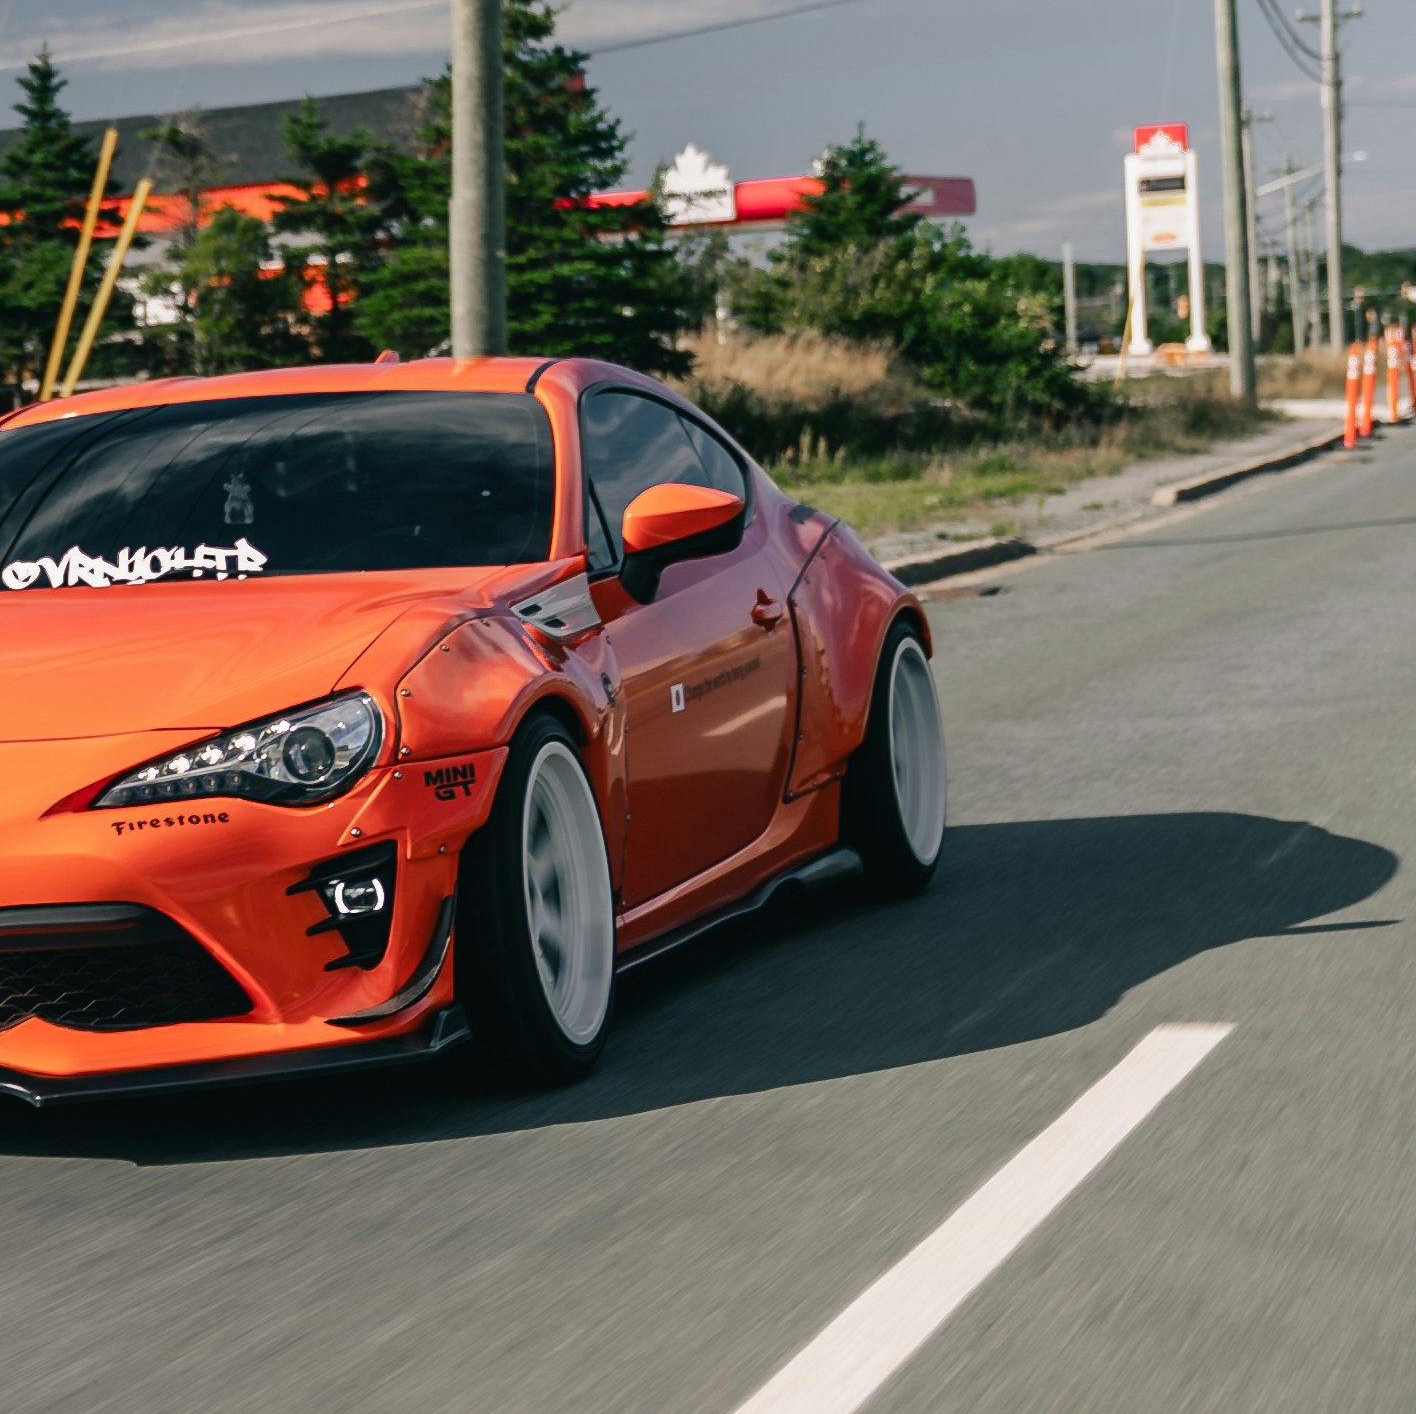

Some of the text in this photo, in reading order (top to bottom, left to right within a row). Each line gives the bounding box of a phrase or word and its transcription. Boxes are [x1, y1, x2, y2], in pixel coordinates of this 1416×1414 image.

[424, 763, 476, 786] MINI
[435, 778, 477, 801] GT
[111, 812, 230, 835] Firestone
